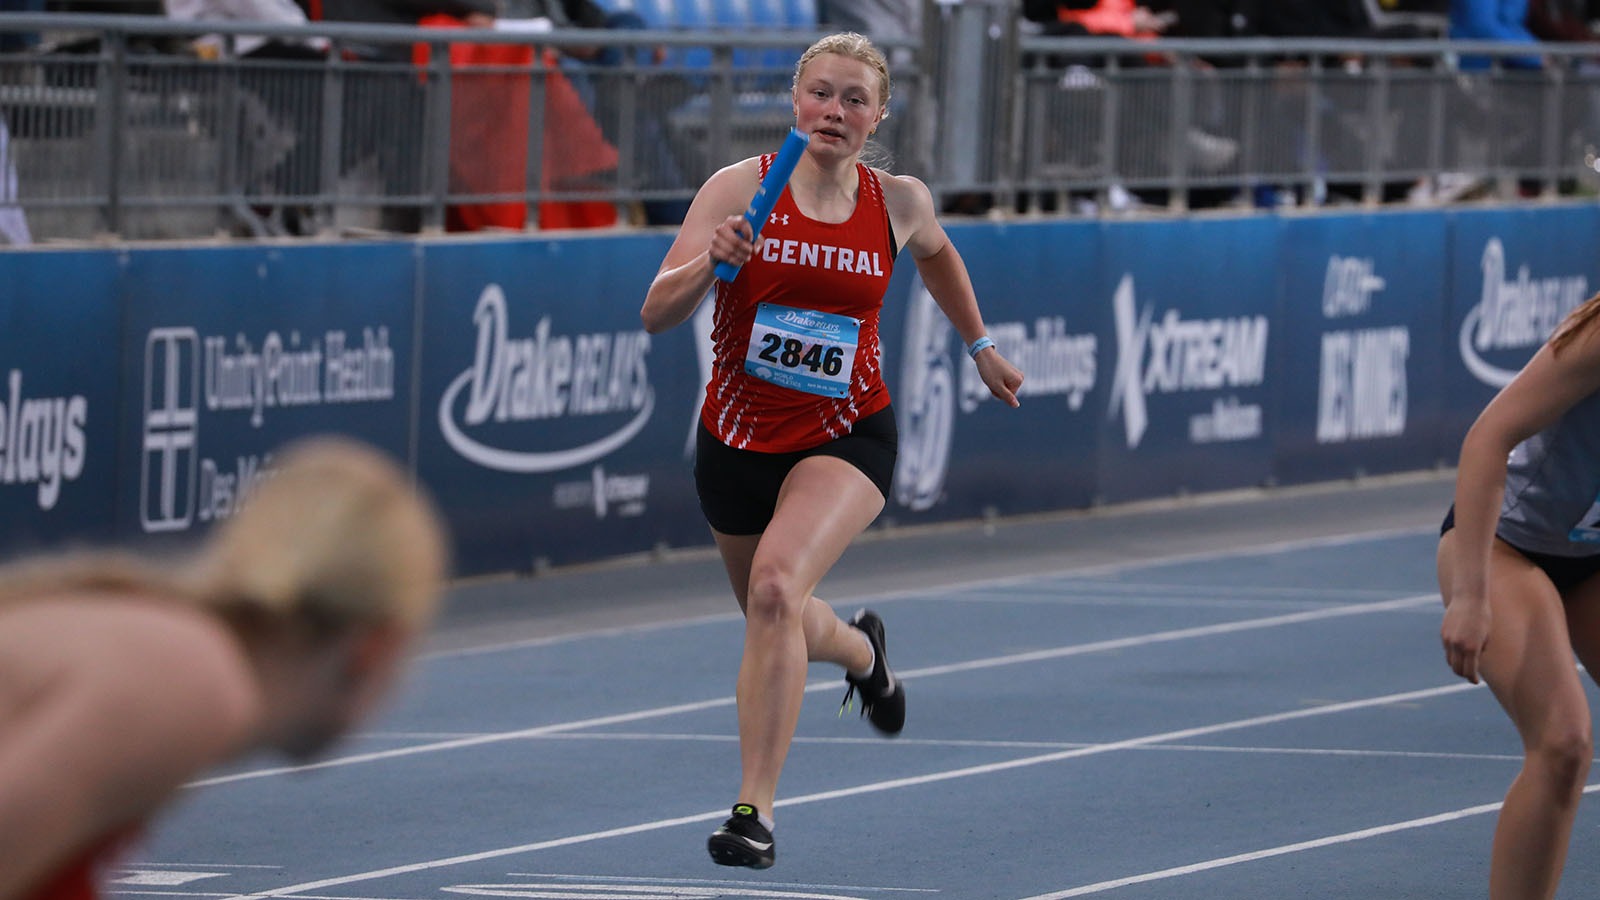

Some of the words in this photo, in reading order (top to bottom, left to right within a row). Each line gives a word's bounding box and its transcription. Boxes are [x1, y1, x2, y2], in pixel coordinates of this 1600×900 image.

[762, 238, 885, 277] CENTRAL
[784, 311, 815, 328] Drake
[815, 321, 840, 332] RELAYS
[464, 282, 572, 426] Drake
[570, 330, 653, 416] RELAYS
[758, 333, 844, 377] 2846
[204, 330, 321, 429] UnityPoint
[325, 325, 394, 401] Health
